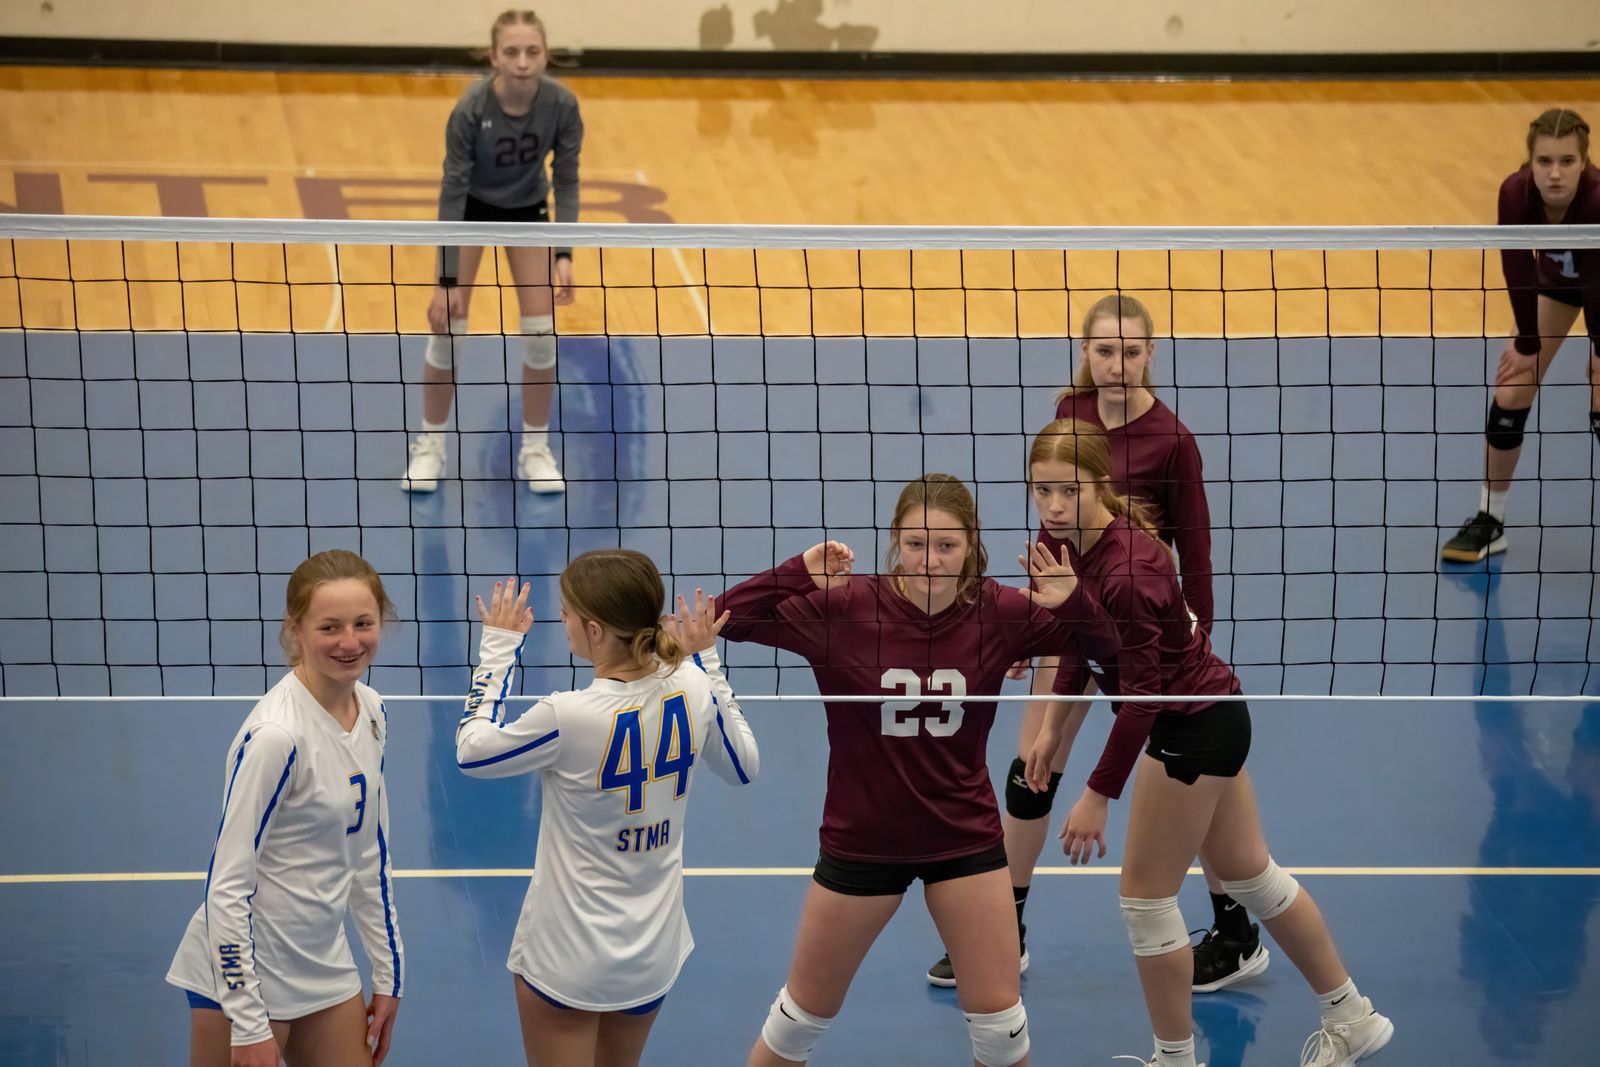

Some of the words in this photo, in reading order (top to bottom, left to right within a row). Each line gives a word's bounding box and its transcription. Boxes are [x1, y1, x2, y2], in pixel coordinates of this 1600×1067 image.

[495, 133, 540, 168] 22
[881, 668, 967, 737] 23
[597, 690, 697, 815] 44
[346, 771, 367, 836] 3
[616, 818, 670, 852] STMA
[219, 943, 245, 991] STMA
